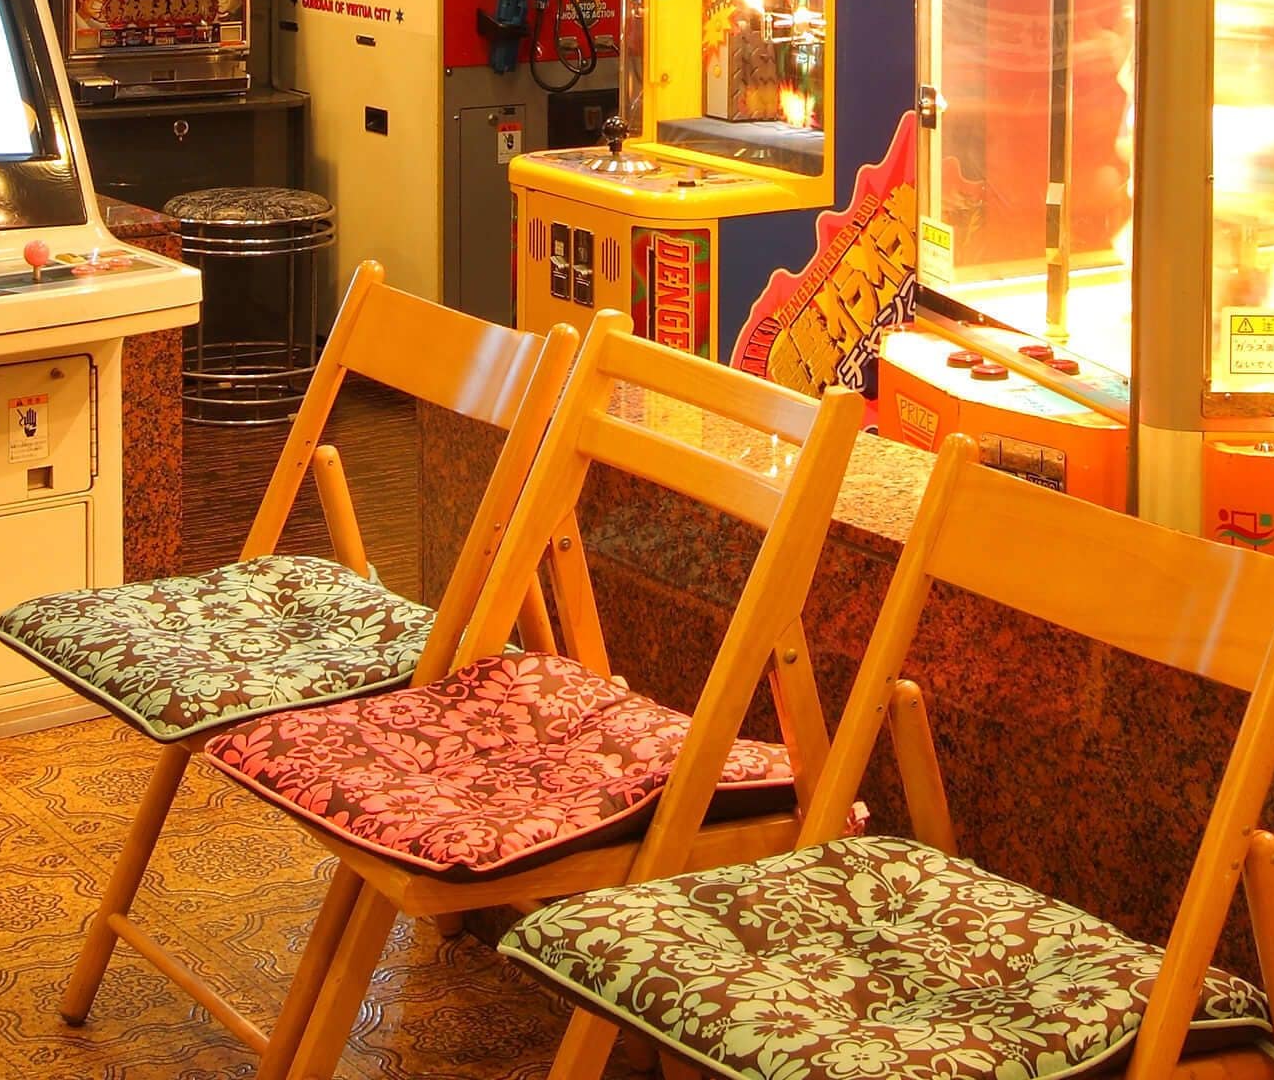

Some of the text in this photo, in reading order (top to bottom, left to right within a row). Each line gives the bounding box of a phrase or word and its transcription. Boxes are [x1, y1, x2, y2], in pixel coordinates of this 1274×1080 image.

[335, 1, 345, 15] OF
[346, 3, 374, 20] VIRTUA
[374, 6, 391, 23] CITY
[595, 10, 615, 19] ACTION
[858, 193, 880, 226] BOU
[655, 235, 692, 353] DENGE
[899, 398, 936, 435] PRIZE
